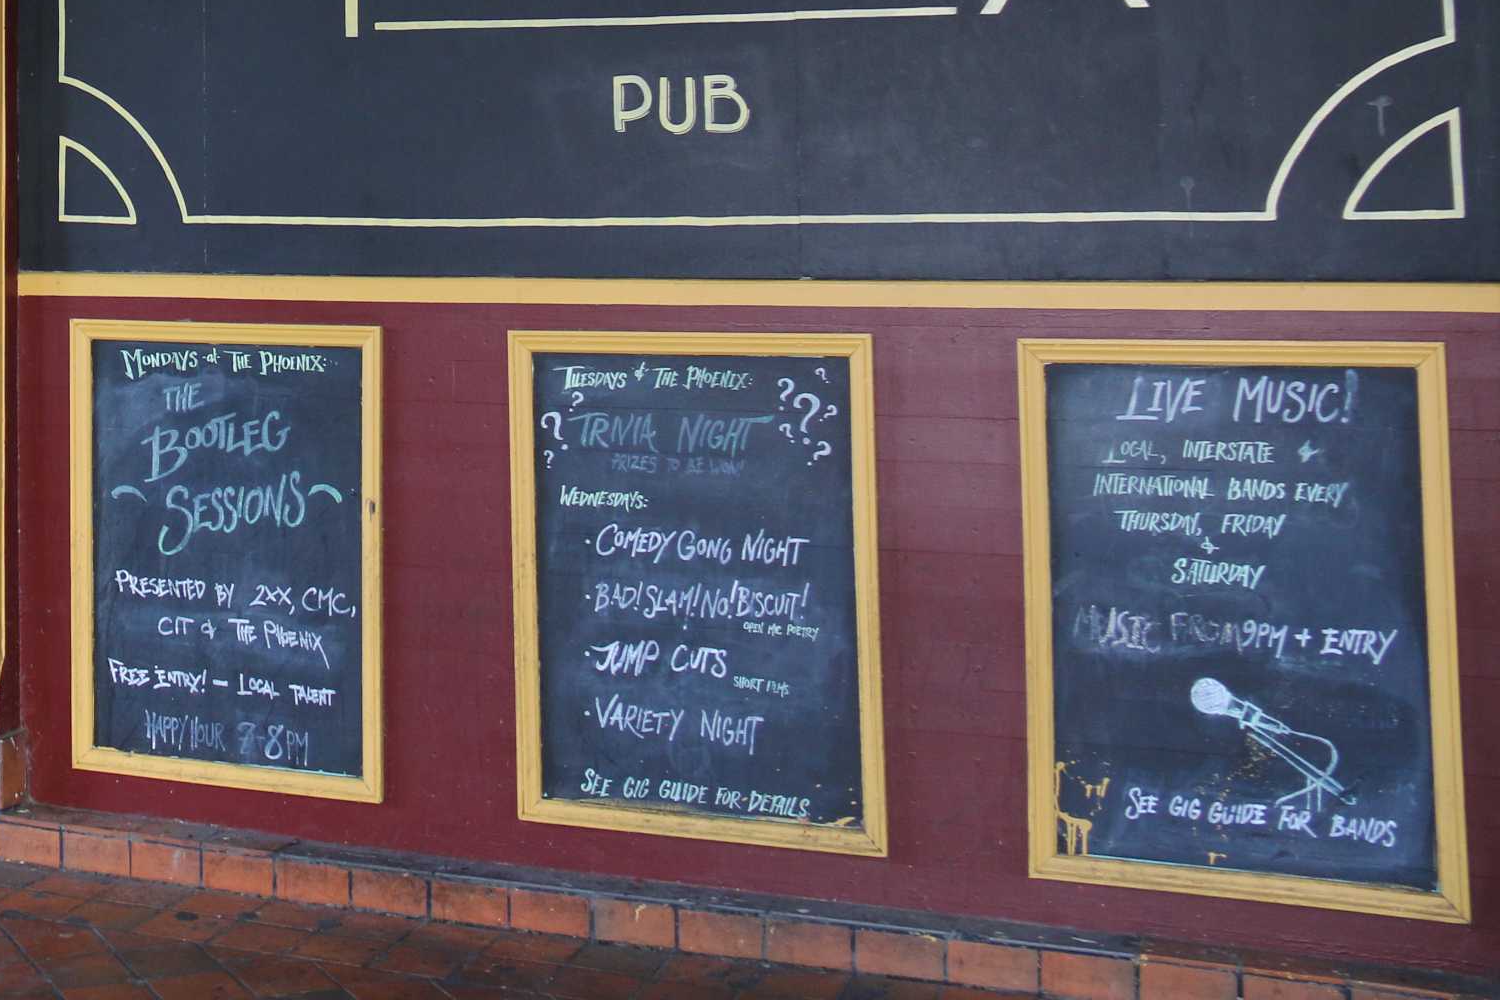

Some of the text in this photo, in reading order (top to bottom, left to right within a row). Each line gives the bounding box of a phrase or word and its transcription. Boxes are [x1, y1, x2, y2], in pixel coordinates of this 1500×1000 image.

[612, 74, 751, 135] PUB
[121, 349, 198, 380] MONDAYS
[223, 351, 252, 372] THE
[552, 366, 627, 390] TUESDAYS
[652, 367, 679, 389] THE
[163, 383, 204, 413] THE
[1115, 369, 1357, 424] LIVE MUSIC!
[140, 410, 291, 483] BOOTLEG
[567, 412, 775, 457] TRIVIA NIGHT
[1183, 439, 1275, 465] INTERSTATE
[1092, 473, 1349, 508] INTERNATIONAL BANDS EVERY
[158, 471, 306, 556] SESSIONS
[1221, 513, 1287, 539] FRIDAY
[596, 523, 810, 567] COMEDY GONG NIGHT
[115, 569, 205, 600] PRESENTED
[214, 582, 234, 608] BY
[1171, 557, 1266, 589] SATURDAY
[157, 616, 194, 636] CIT
[228, 618, 257, 643] THE
[263, 620, 330, 670] PHOENIX
[786, 624, 819, 639] POETRY
[1072, 604, 1162, 653] MUSIC
[1169, 612, 1243, 655] FROM
[1242, 619, 1289, 659] 9PM
[1319, 628, 1398, 665] ENTRY
[590, 640, 729, 679] JUMP CUTS
[107, 657, 150, 687] FREE
[153, 665, 207, 693] ENTRY!
[237, 673, 280, 699] LOCAL
[288, 684, 336, 706] TALENT
[732, 675, 764, 693] SHORT
[145, 709, 188, 750] HAPPY
[191, 716, 225, 751] HOUR
[594, 693, 765, 756] VARIETY NIGHT
[580, 767, 811, 818] SEE GIG GUIDE FOR DETAILS
[1124, 787, 1399, 848] SEE GIG GUIDE FOR BANDS
